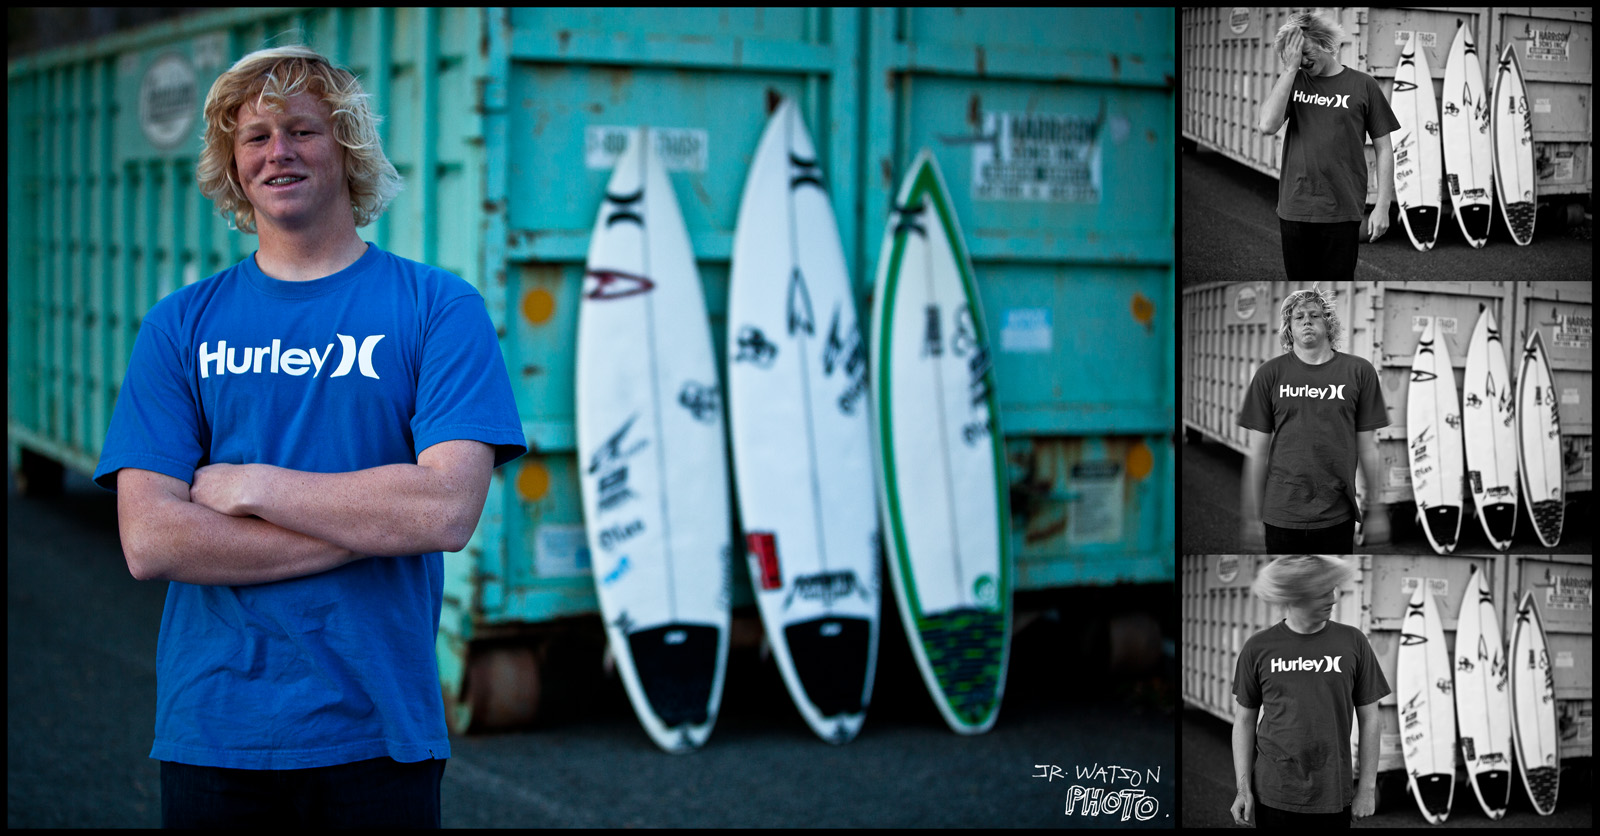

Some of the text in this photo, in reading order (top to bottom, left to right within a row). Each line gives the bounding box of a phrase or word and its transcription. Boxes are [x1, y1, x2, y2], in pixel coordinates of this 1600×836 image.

[1293, 90, 1335, 107] Hurley
[199, 339, 335, 379] Hurley
[1279, 384, 1329, 400] Hurley
[1271, 656, 1325, 673] Hurley
